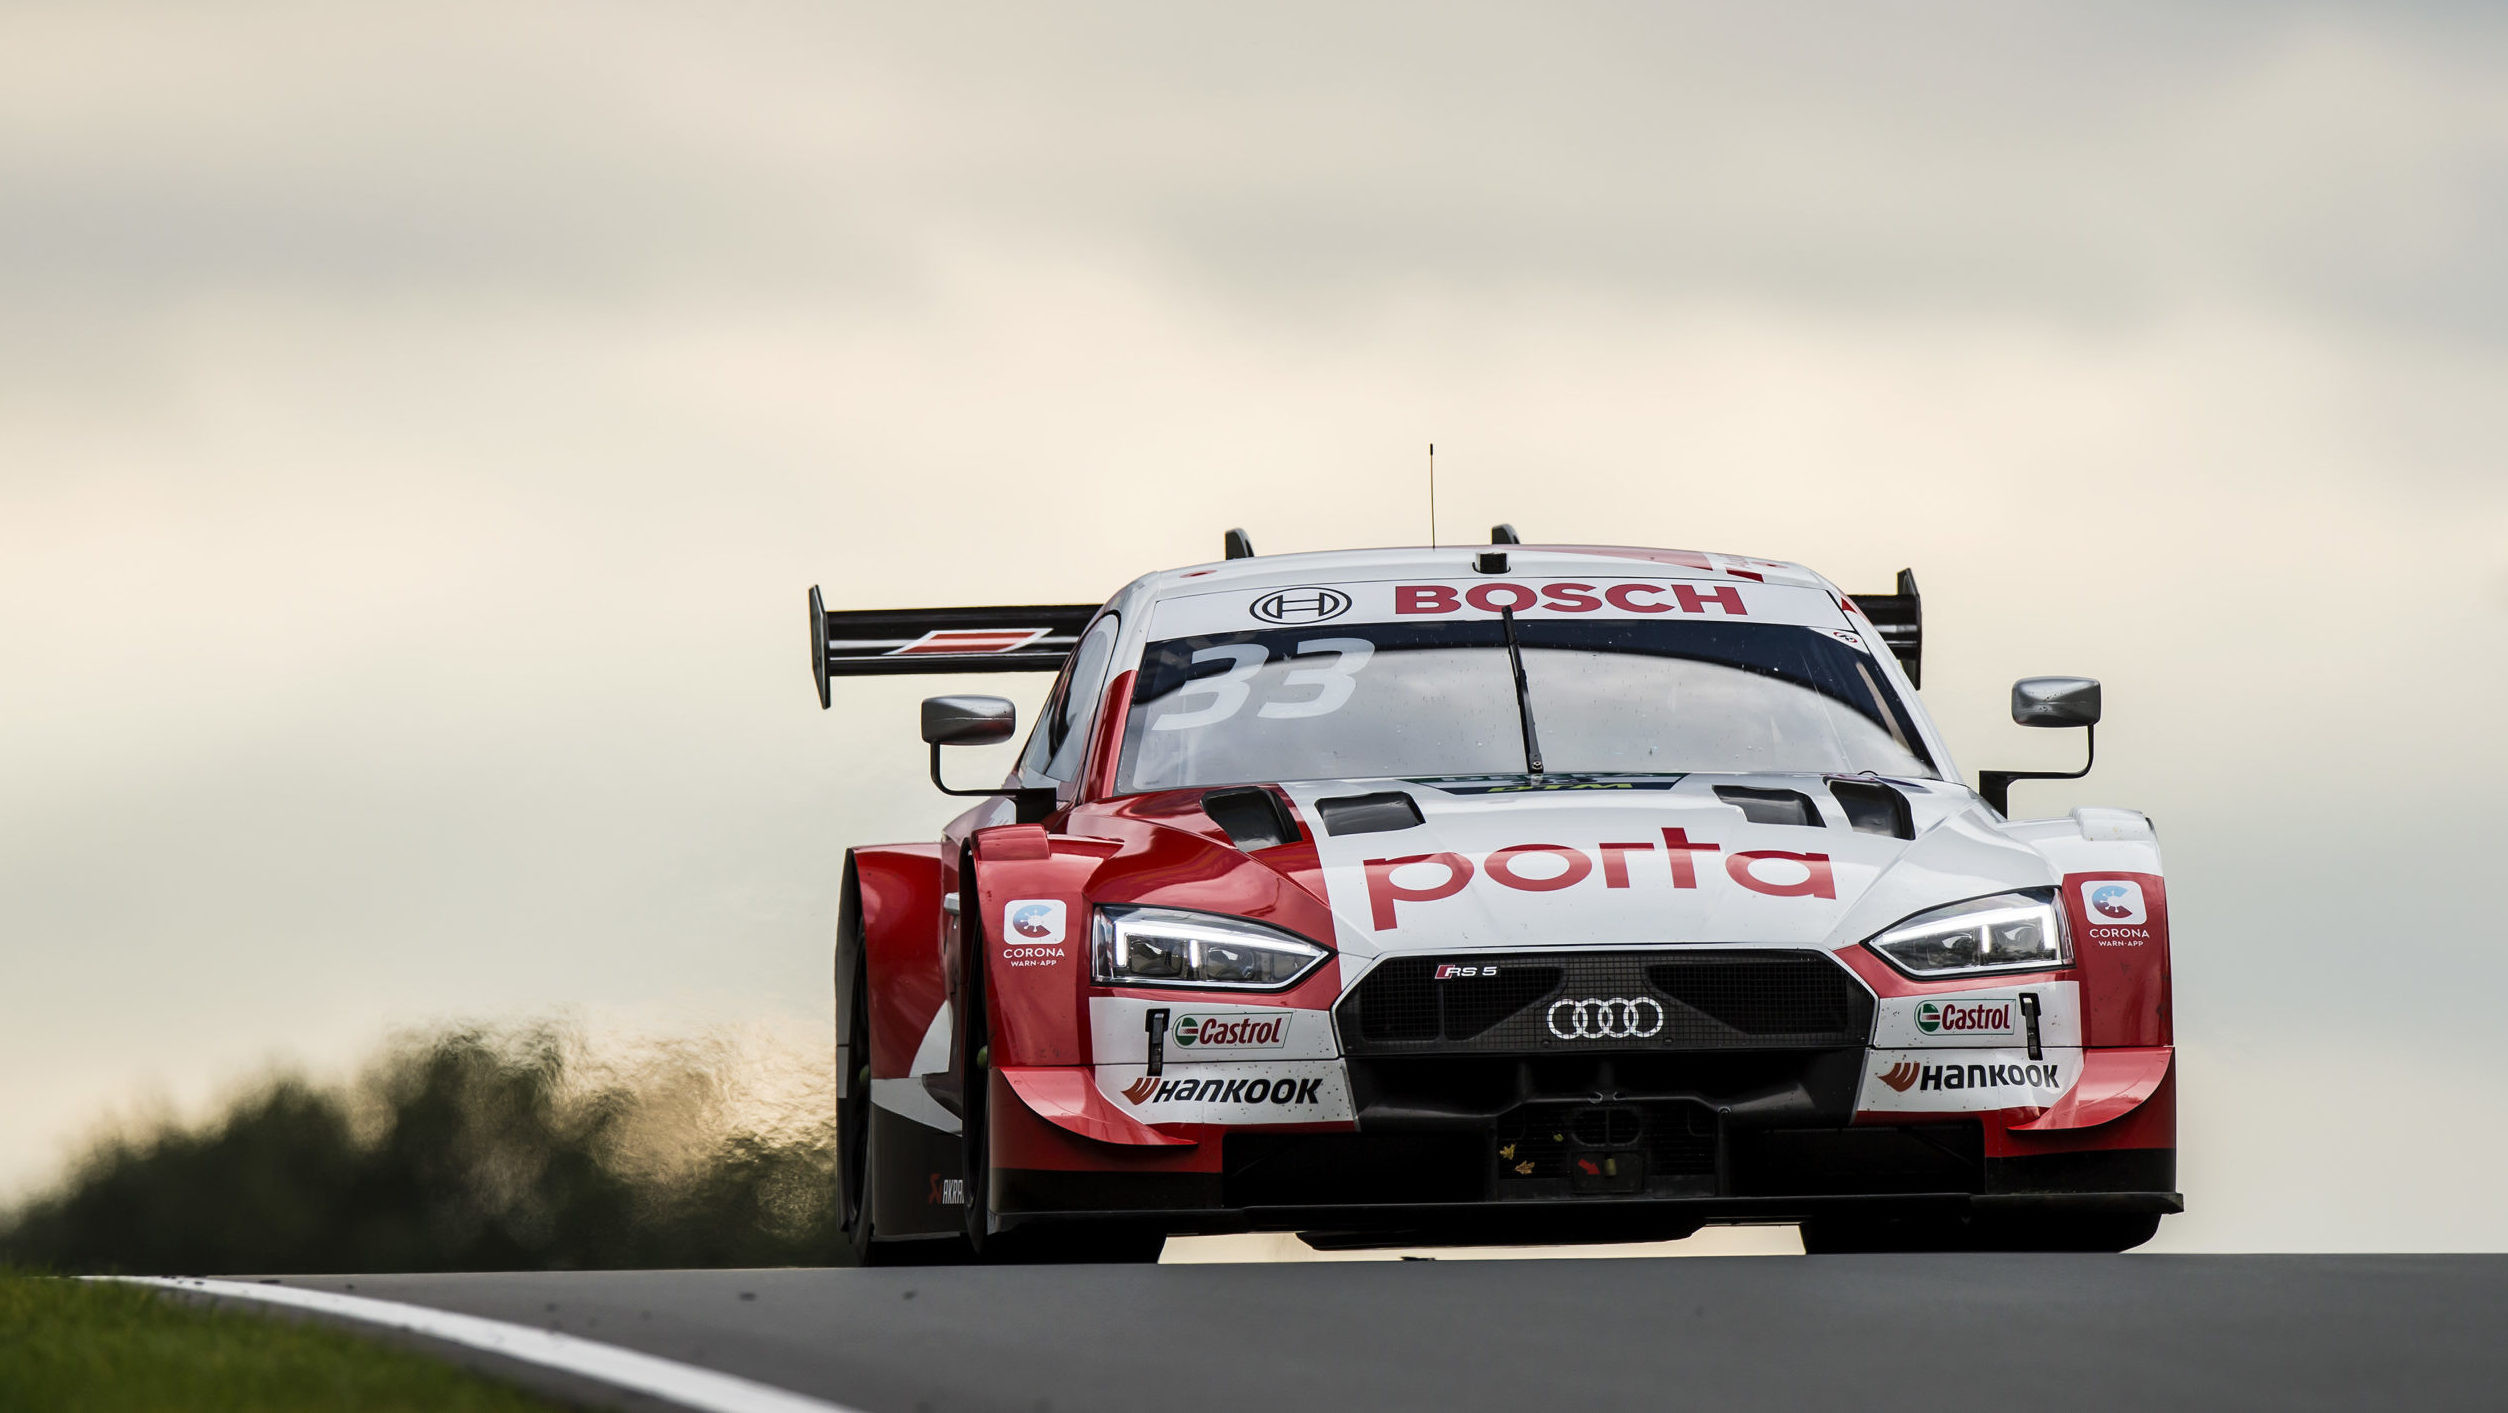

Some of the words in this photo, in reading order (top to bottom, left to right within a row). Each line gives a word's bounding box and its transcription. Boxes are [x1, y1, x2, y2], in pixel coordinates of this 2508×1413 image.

[1395, 582, 1749, 616] BOSCH
[1151, 637, 1376, 731] 33
[1363, 827, 1837, 931] porta
[2089, 928, 2150, 938] CORONA
[1003, 948, 1065, 958] CORONA
[1444, 966, 1478, 977] RS
[1482, 966, 1498, 976] 5
[1199, 1017, 1282, 1045] Castrol
[1942, 1003, 2011, 1031] Castrol
[942, 1179, 965, 1205] AKRA
